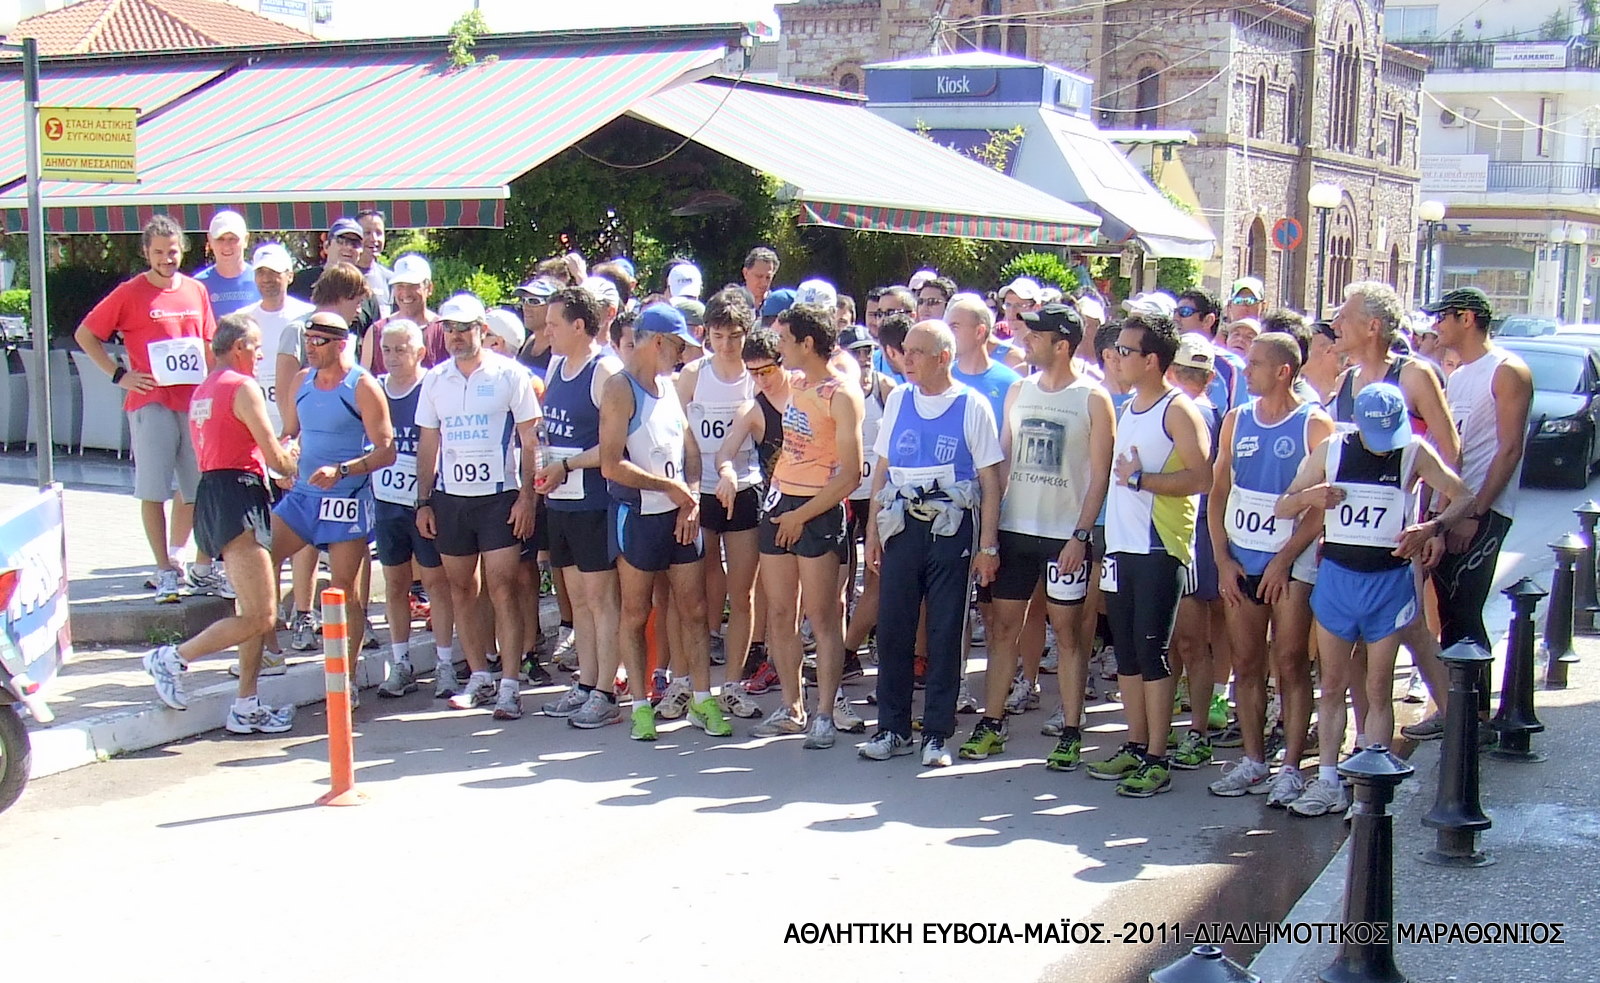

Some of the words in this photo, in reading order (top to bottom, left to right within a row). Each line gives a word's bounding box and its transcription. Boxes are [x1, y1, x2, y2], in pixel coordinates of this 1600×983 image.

[937, 75, 970, 94] Kiosk
[65, 119, 94, 129] ΣΤΑΣΗ
[96, 120, 133, 130] ΑΣΤΙΚΗΣ
[67, 131, 132, 142] ΣΥΓΚΟΙΝΩΝΙΑΣ
[45, 158, 78, 167] ΔΗΜΟΥ
[80, 158, 134, 169] ΜΕΣΣΑΠΙΩΝ
[166, 354, 199, 371] 082
[445, 413, 489, 428] ΣΔΥΜ
[446, 429, 489, 441] ΘΗΒΑΣ
[381, 469, 417, 491] 037
[453, 463, 490, 482] 093
[322, 499, 357, 519] 106
[1340, 504, 1388, 529] 047
[1235, 508, 1276, 535] 004
